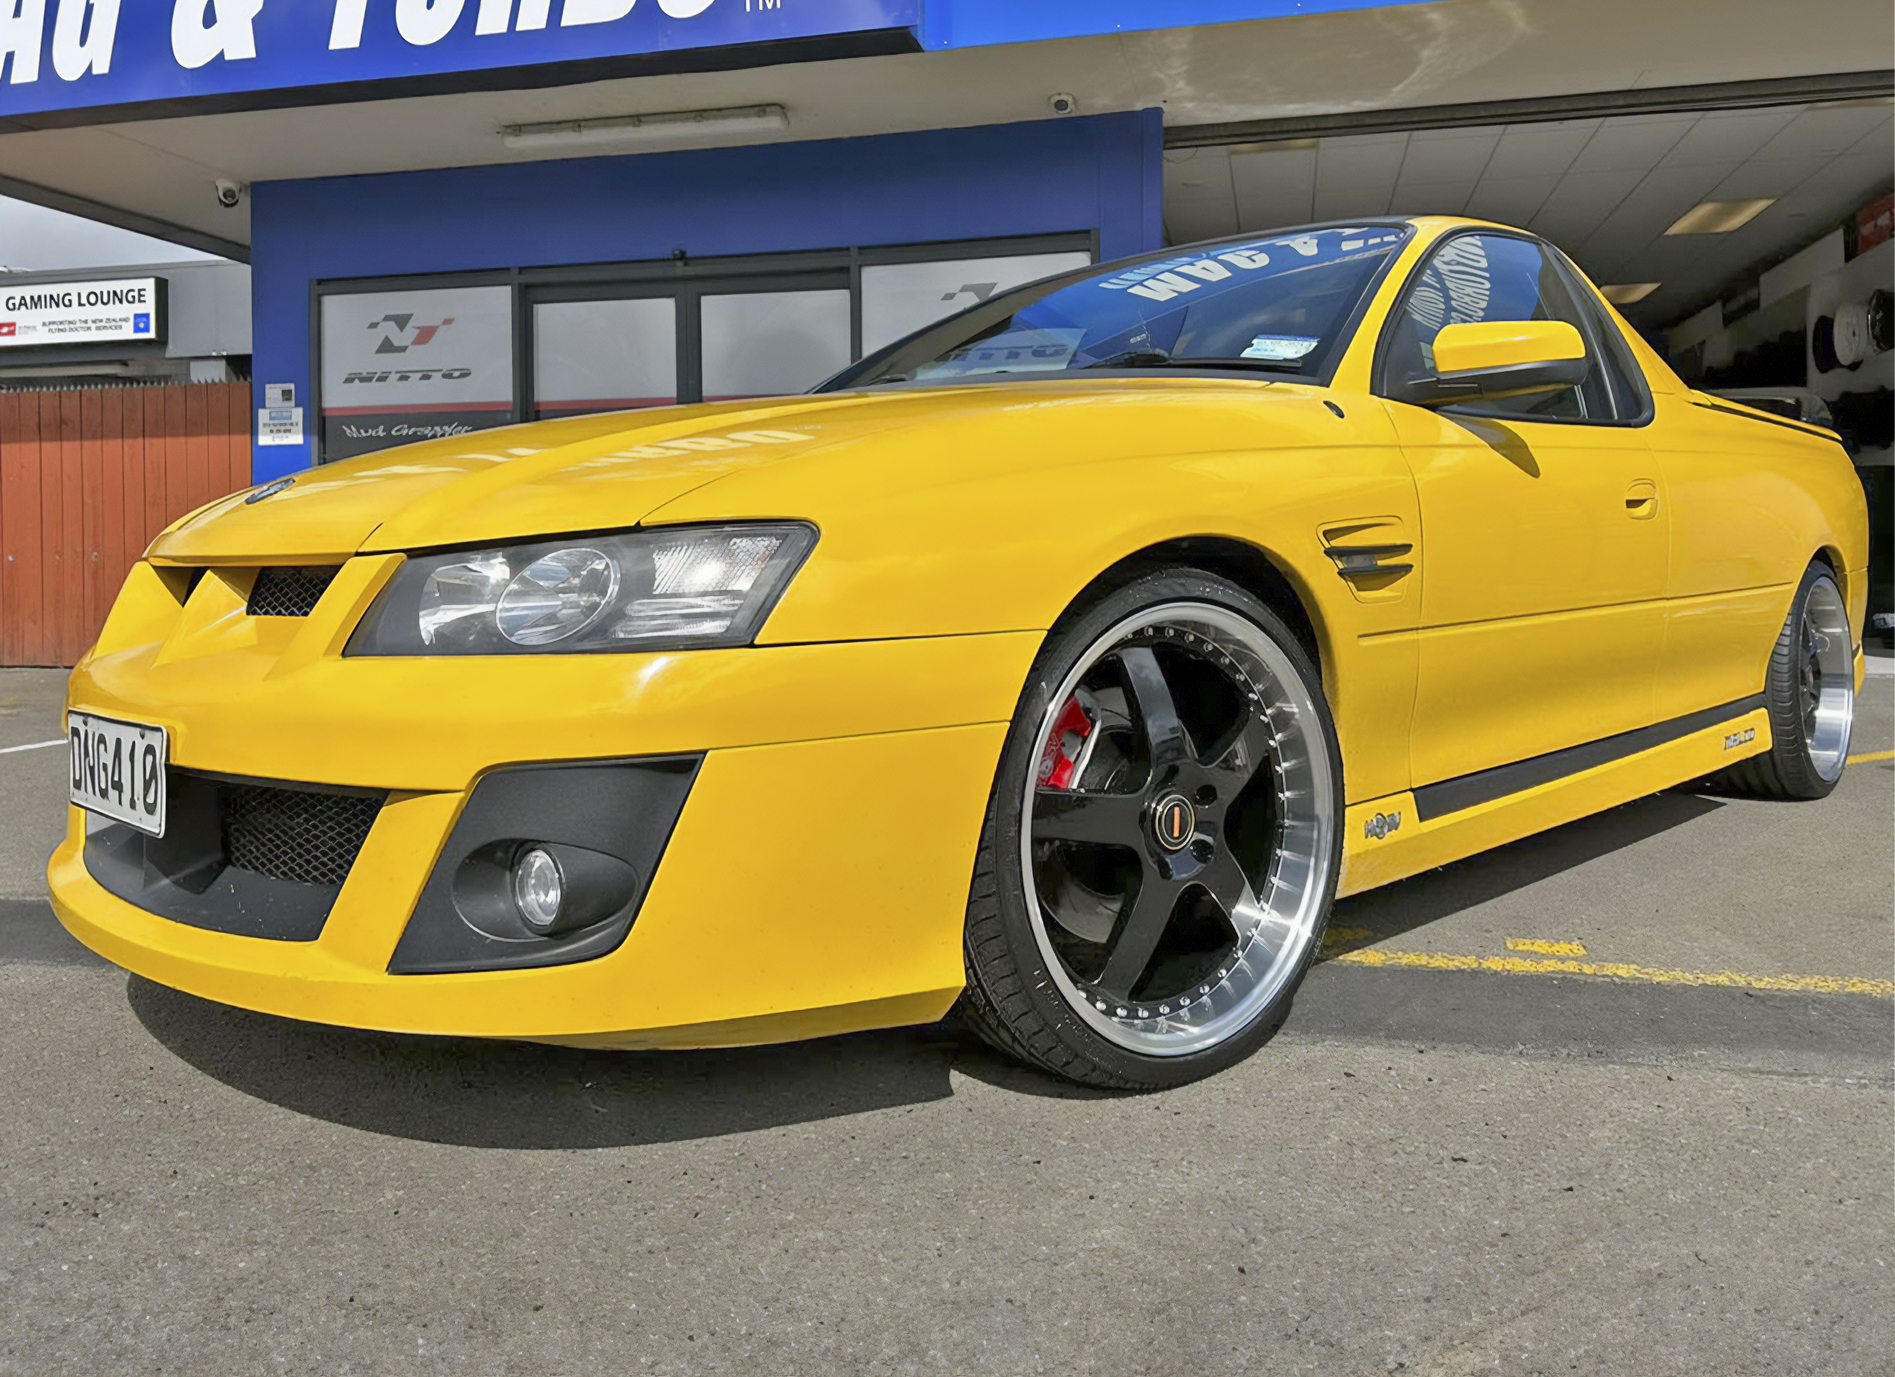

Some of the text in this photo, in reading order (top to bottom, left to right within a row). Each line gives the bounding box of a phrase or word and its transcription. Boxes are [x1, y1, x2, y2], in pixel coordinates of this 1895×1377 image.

[5, 288, 147, 312] GAMING LOUNGE
[342, 368, 472, 384] NITTO
[342, 425, 387, 438] Mud
[71, 727, 158, 816] DNG410
